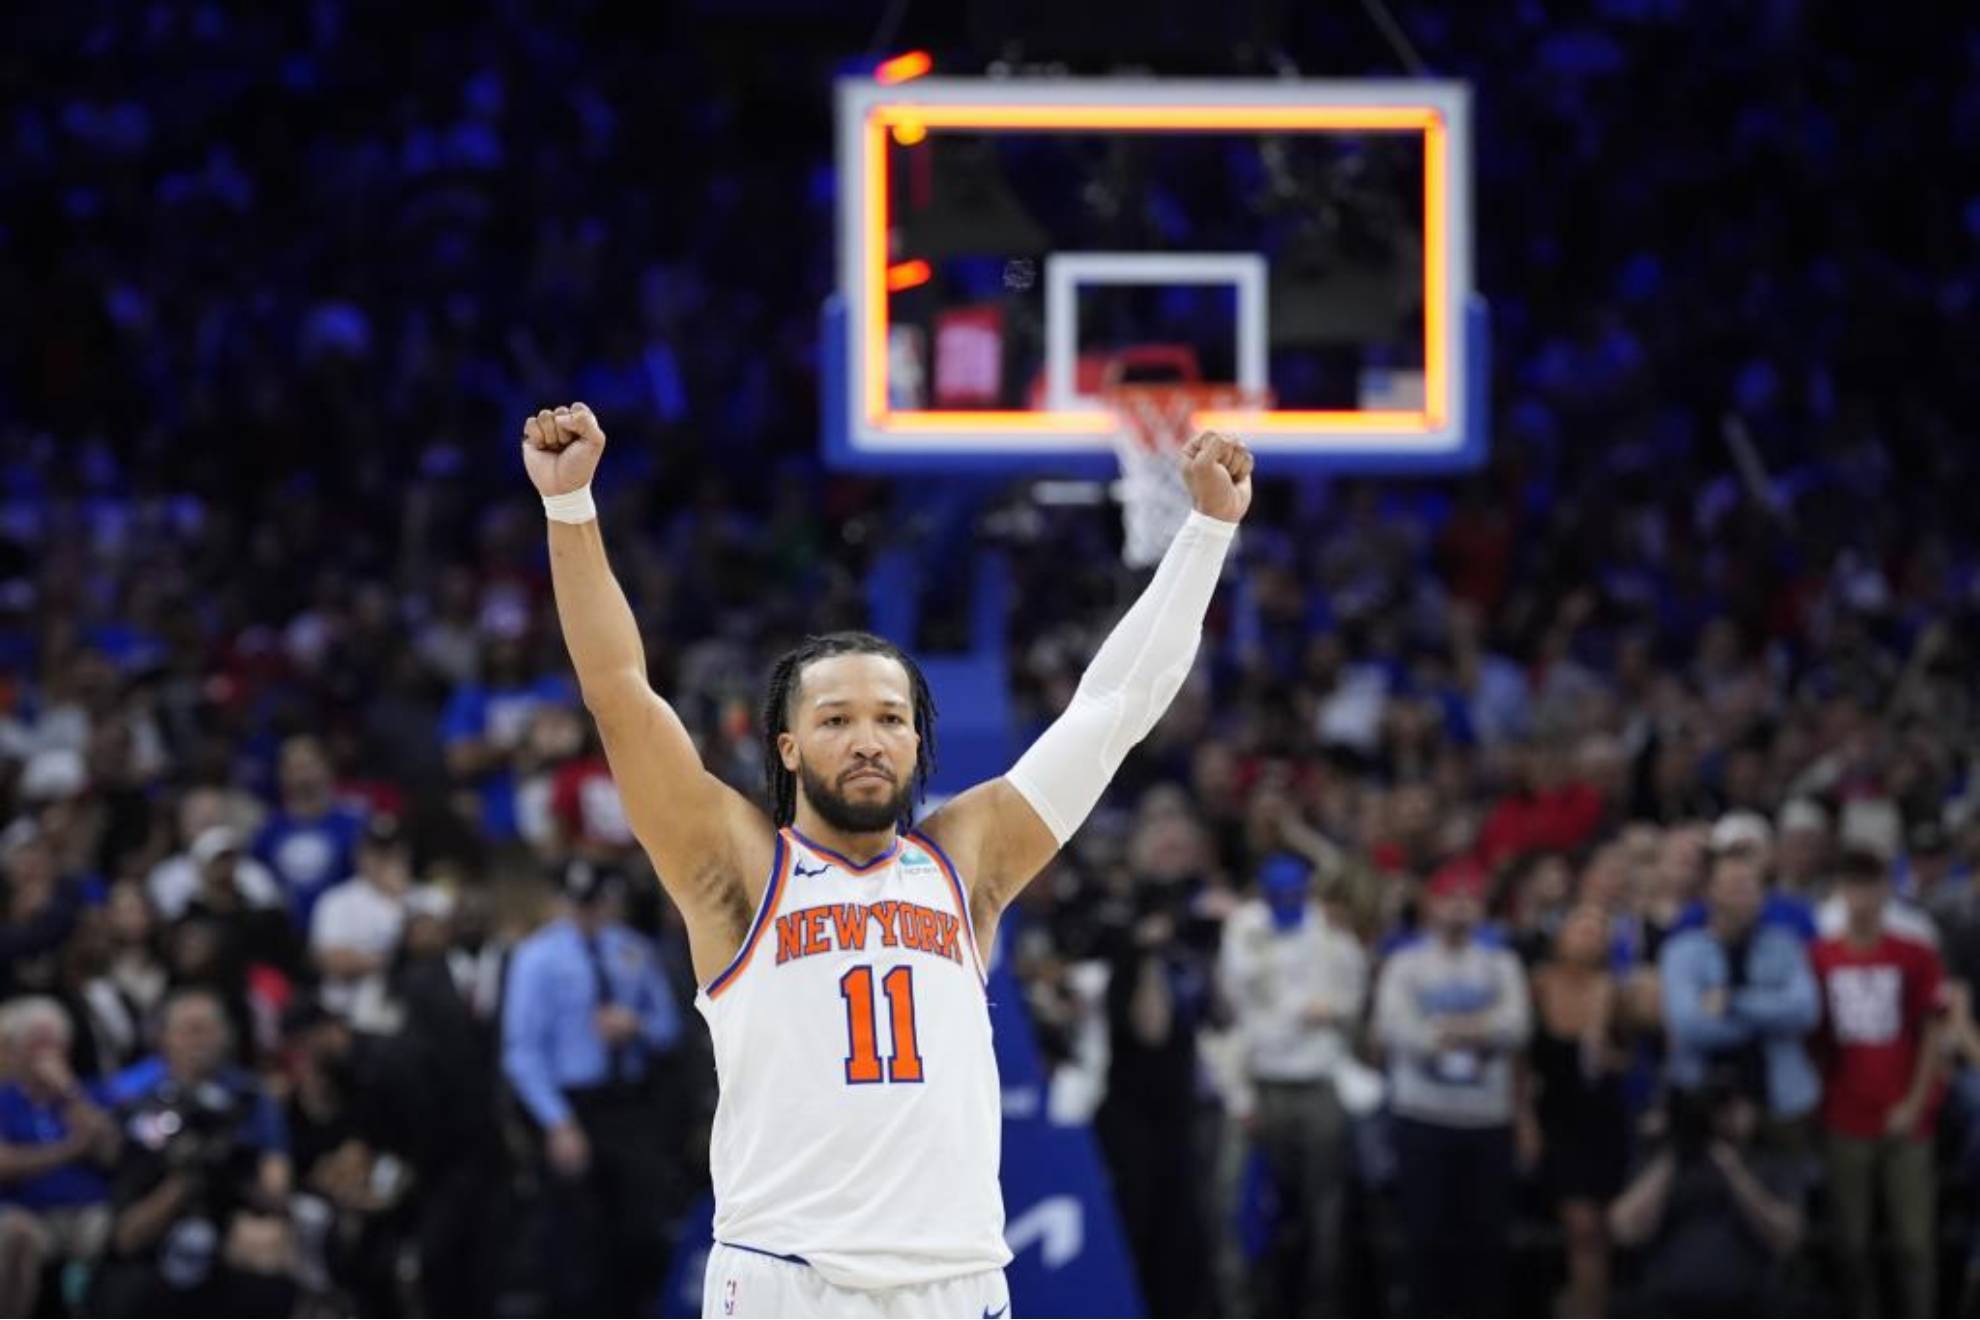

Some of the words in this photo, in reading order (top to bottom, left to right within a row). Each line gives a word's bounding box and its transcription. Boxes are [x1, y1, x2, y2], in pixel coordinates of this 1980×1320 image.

[775, 903, 869, 966] NEW
[869, 900, 963, 966] YORK
[840, 965, 924, 1084] 11
